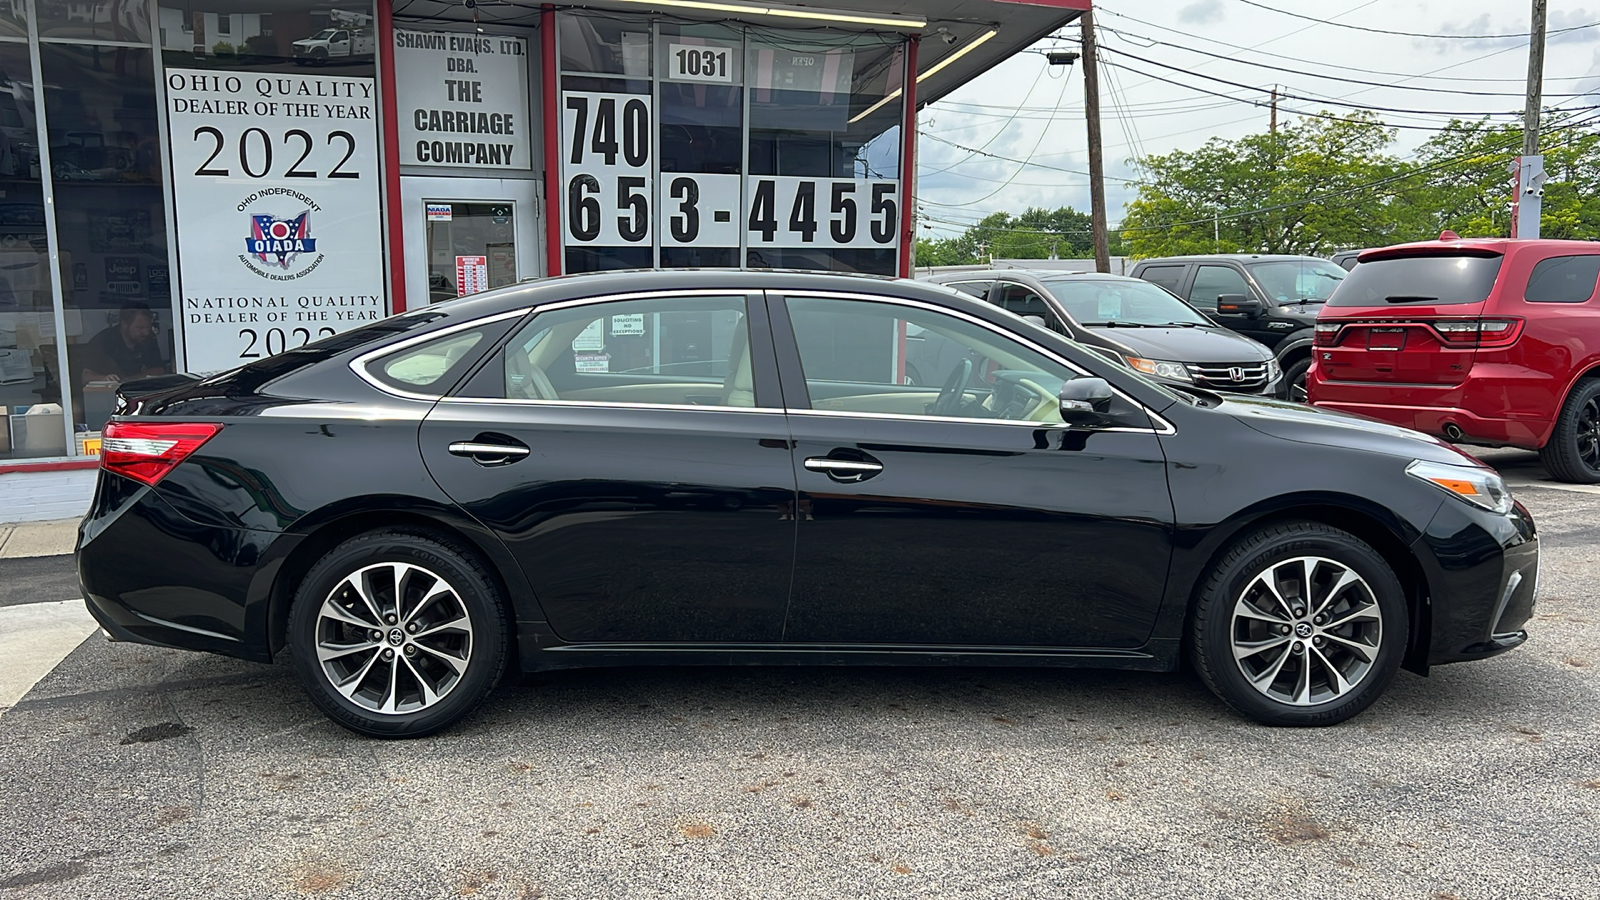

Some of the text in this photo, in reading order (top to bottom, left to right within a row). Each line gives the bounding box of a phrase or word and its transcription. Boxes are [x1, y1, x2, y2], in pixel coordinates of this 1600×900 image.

[396, 33, 446, 50] SHAWN
[500, 40, 525, 56] LTD.
[447, 57, 478, 73] DBA.
[676, 50, 726, 77] 1031
[169, 74, 373, 98] OHIO QUALITY
[444, 79, 482, 102] THE
[173, 98, 371, 119] DEALER OF THE YEAR
[414, 109, 514, 135] CARRIAGE
[566, 97, 648, 168] 740
[193, 126, 359, 179] 2022
[416, 140, 514, 165] COMPANY
[237, 187, 322, 213] OHIO INDEPENDENT
[255, 239, 305, 252] OIADA
[109, 264, 137, 274] Jeep
[238, 254, 269, 279] AUTOMOBILE
[296, 253, 325, 279] ASSOCIATION
[187, 295, 379, 309] NATIONAL QUALITY
[190, 310, 378, 324] DEALER OF THE YEAR
[238, 327, 336, 358] 202
